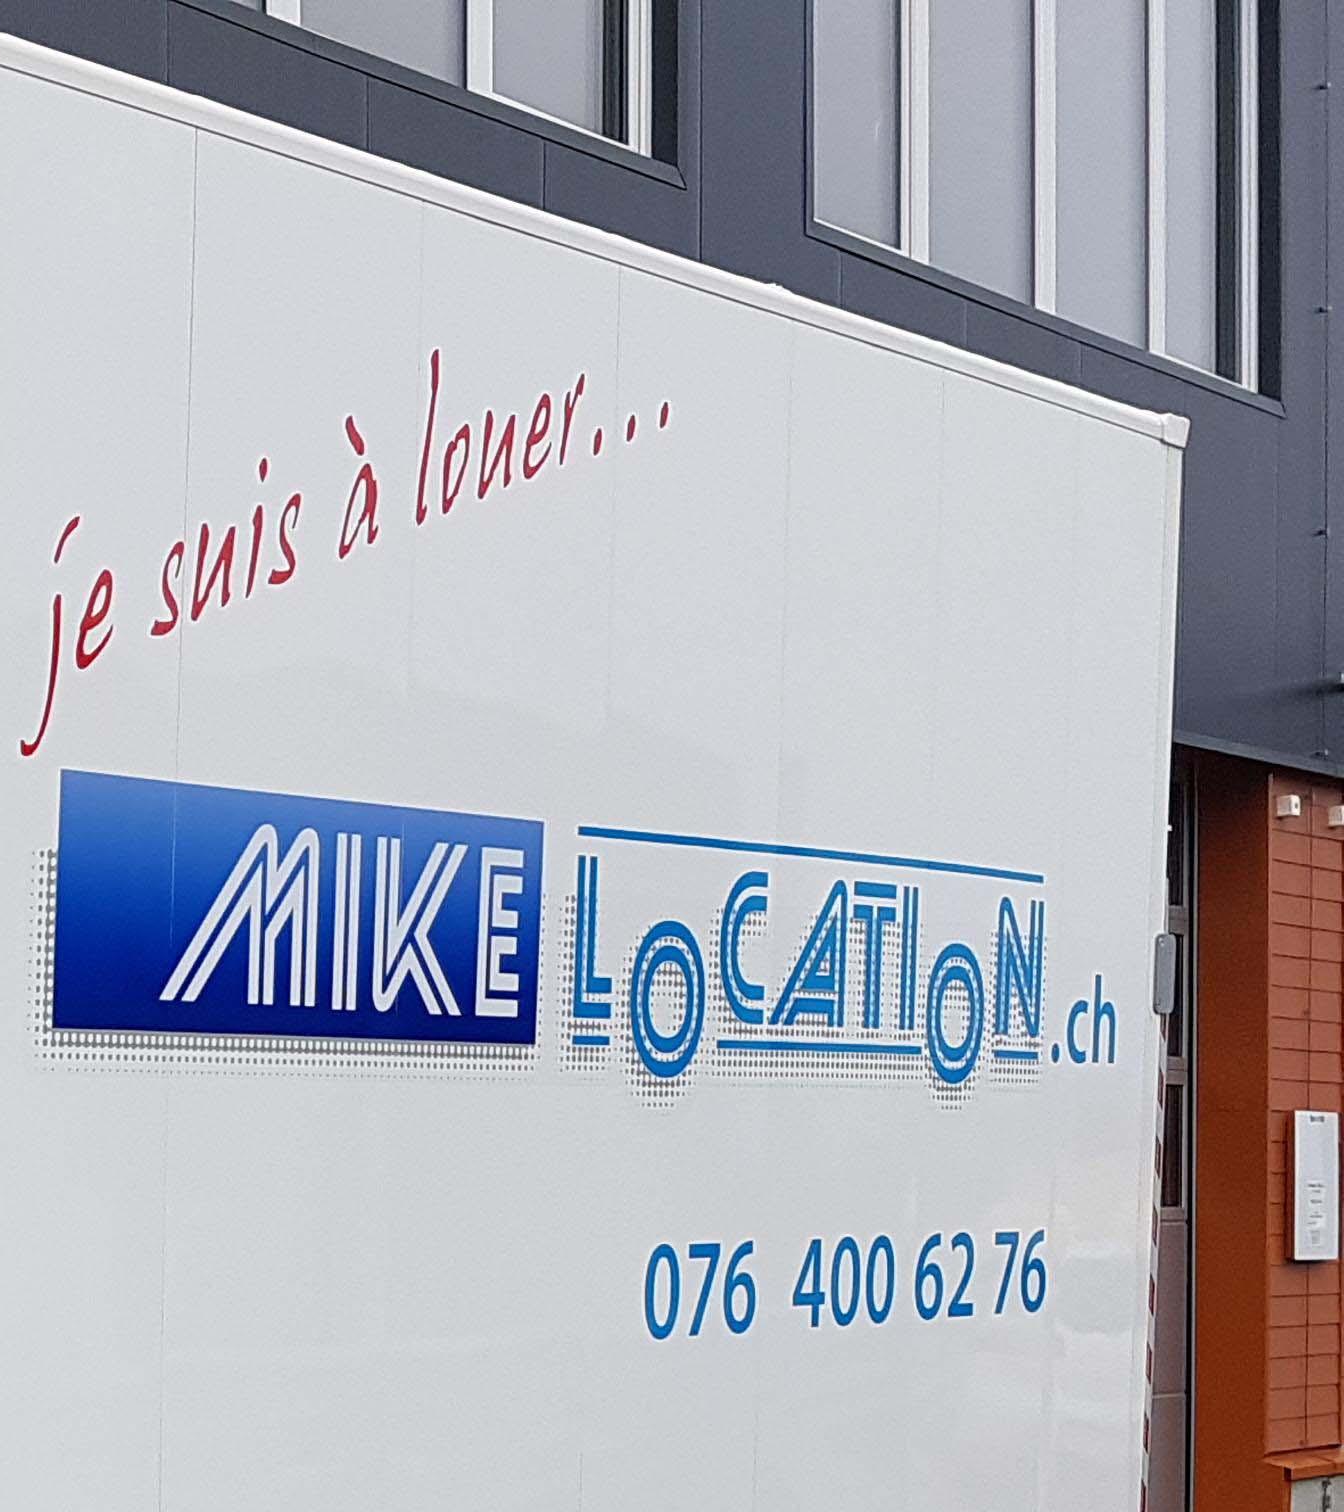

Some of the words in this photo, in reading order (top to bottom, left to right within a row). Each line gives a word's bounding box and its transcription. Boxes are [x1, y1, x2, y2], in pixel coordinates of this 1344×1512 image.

[20, 516, 114, 757] je
[150, 457, 302, 636] suis
[338, 415, 380, 559] à
[414, 348, 670, 526] louer...
[160, 822, 525, 1019] MIKE
[644, 1240, 757, 1340] 076
[792, 1235, 896, 1328] 400
[914, 1232, 975, 1321] 62
[994, 1229, 1047, 1315] 76
